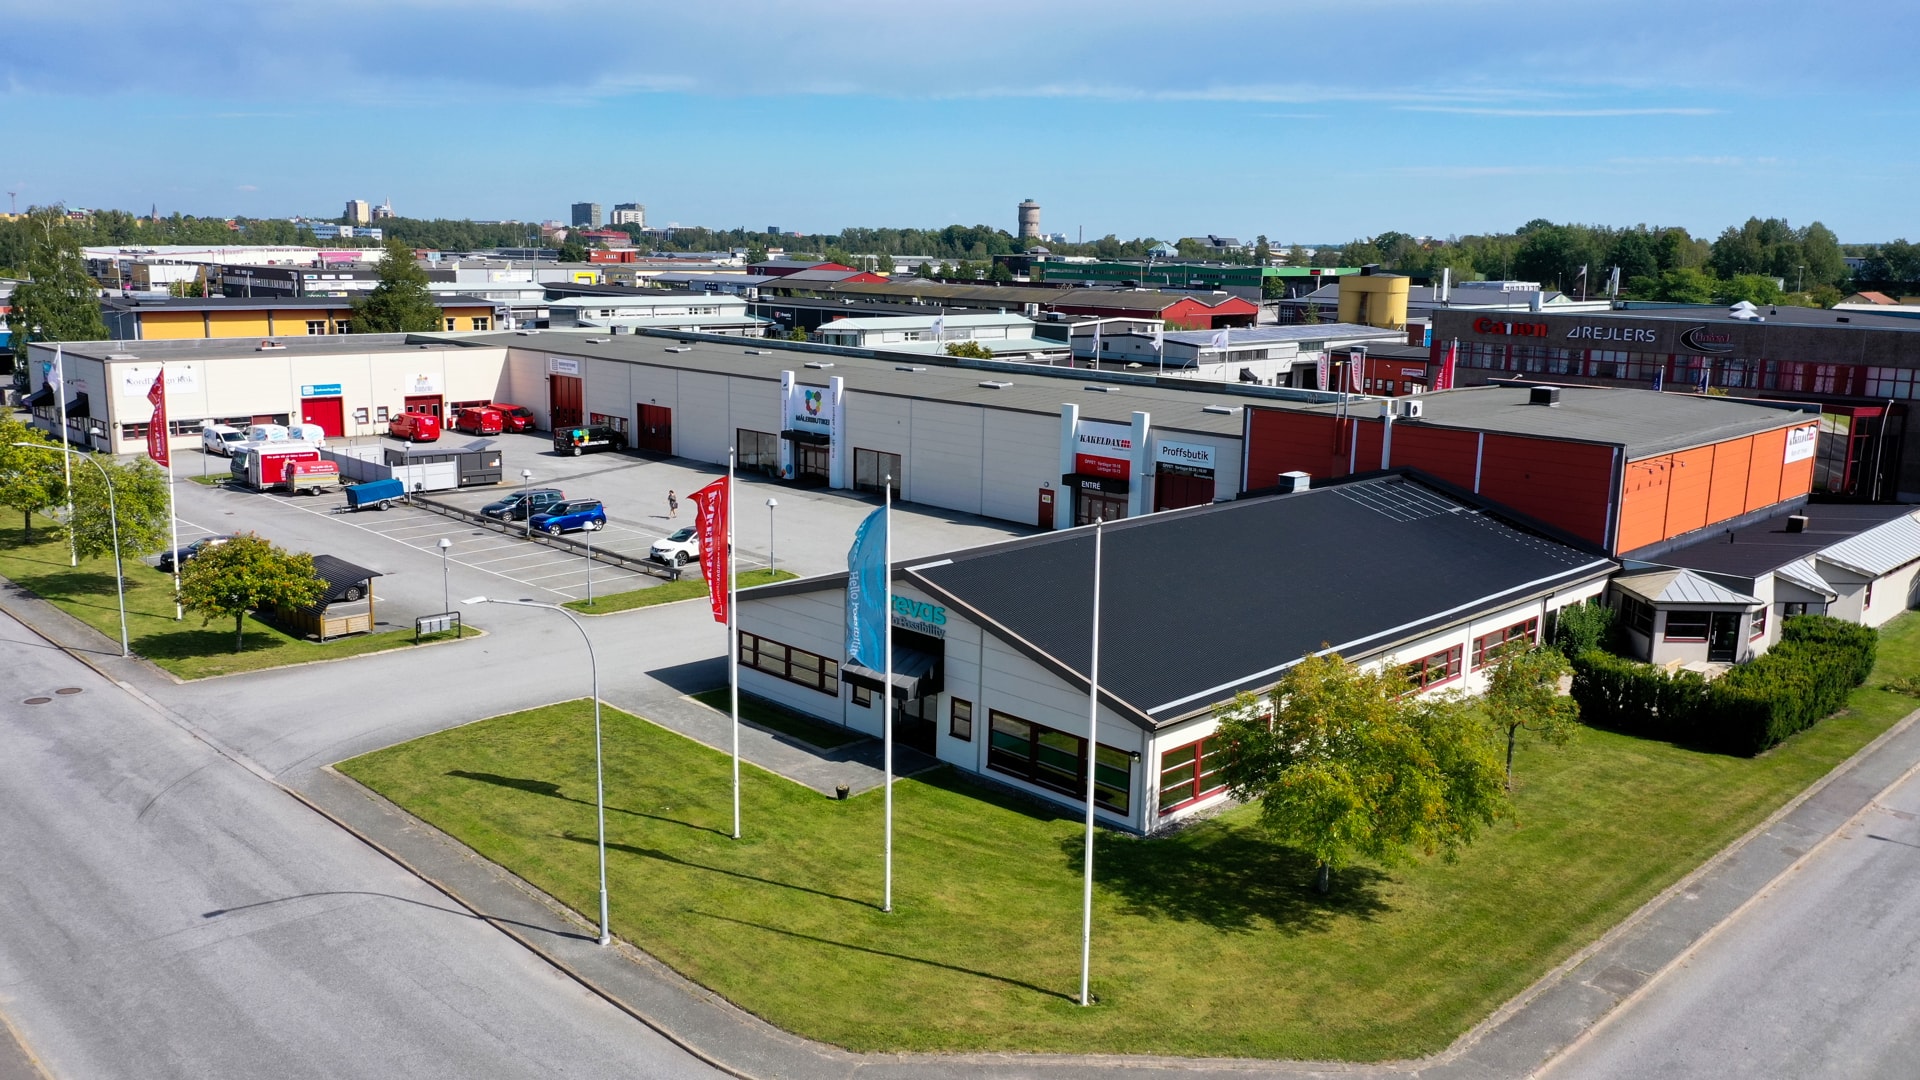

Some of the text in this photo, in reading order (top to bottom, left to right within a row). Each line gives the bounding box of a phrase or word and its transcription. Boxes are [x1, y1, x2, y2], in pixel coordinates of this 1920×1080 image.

[1472, 317, 1548, 338] Canon
[1080, 434, 1121, 448] KAKELDAX
[1162, 446, 1209, 461] Proffsbutik
[1081, 480, 1101, 490] ENTRÉ
[850, 571, 860, 600] Hello
[891, 594, 947, 625] revas
